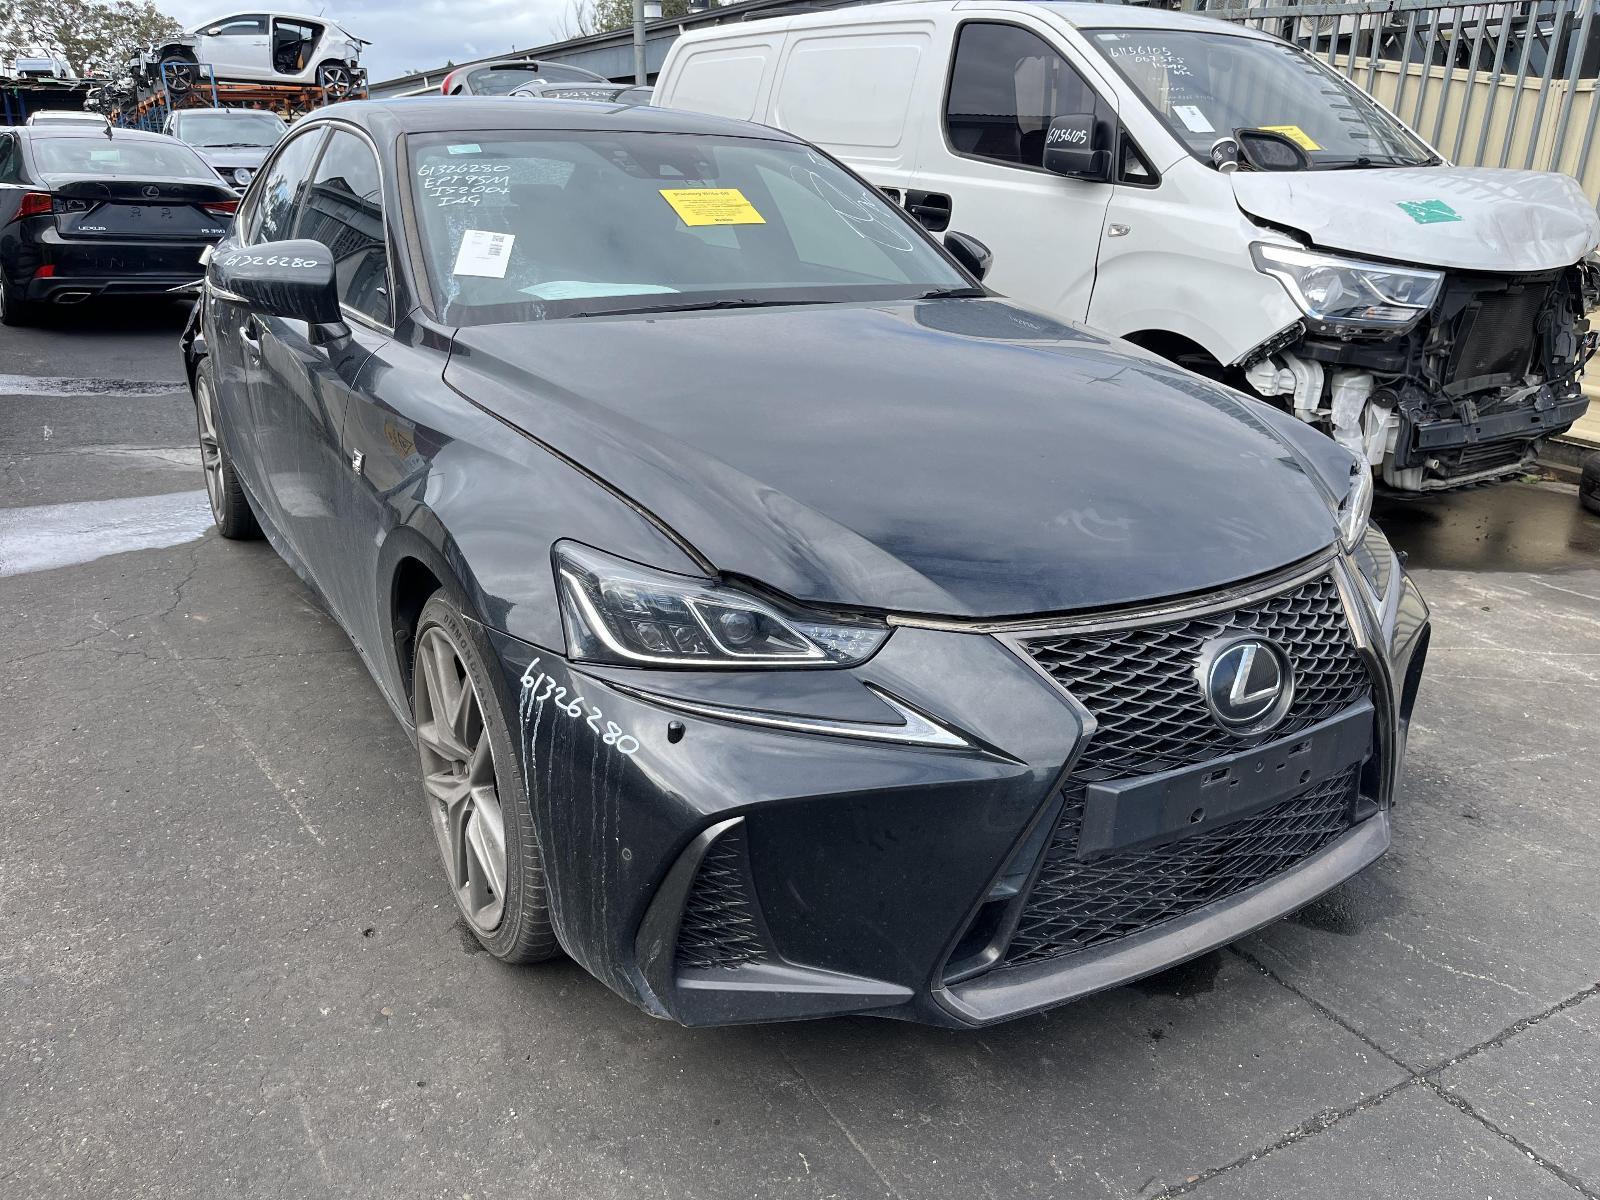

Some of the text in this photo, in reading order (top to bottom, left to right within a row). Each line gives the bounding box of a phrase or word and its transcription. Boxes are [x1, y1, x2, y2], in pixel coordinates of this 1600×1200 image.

[1110, 46, 1172, 57] 61156105
[1047, 127, 1087, 145] 61156105
[418, 164, 511, 176] 61326280
[223, 254, 318, 268] 61326280
[520, 657, 640, 754] 61326280
